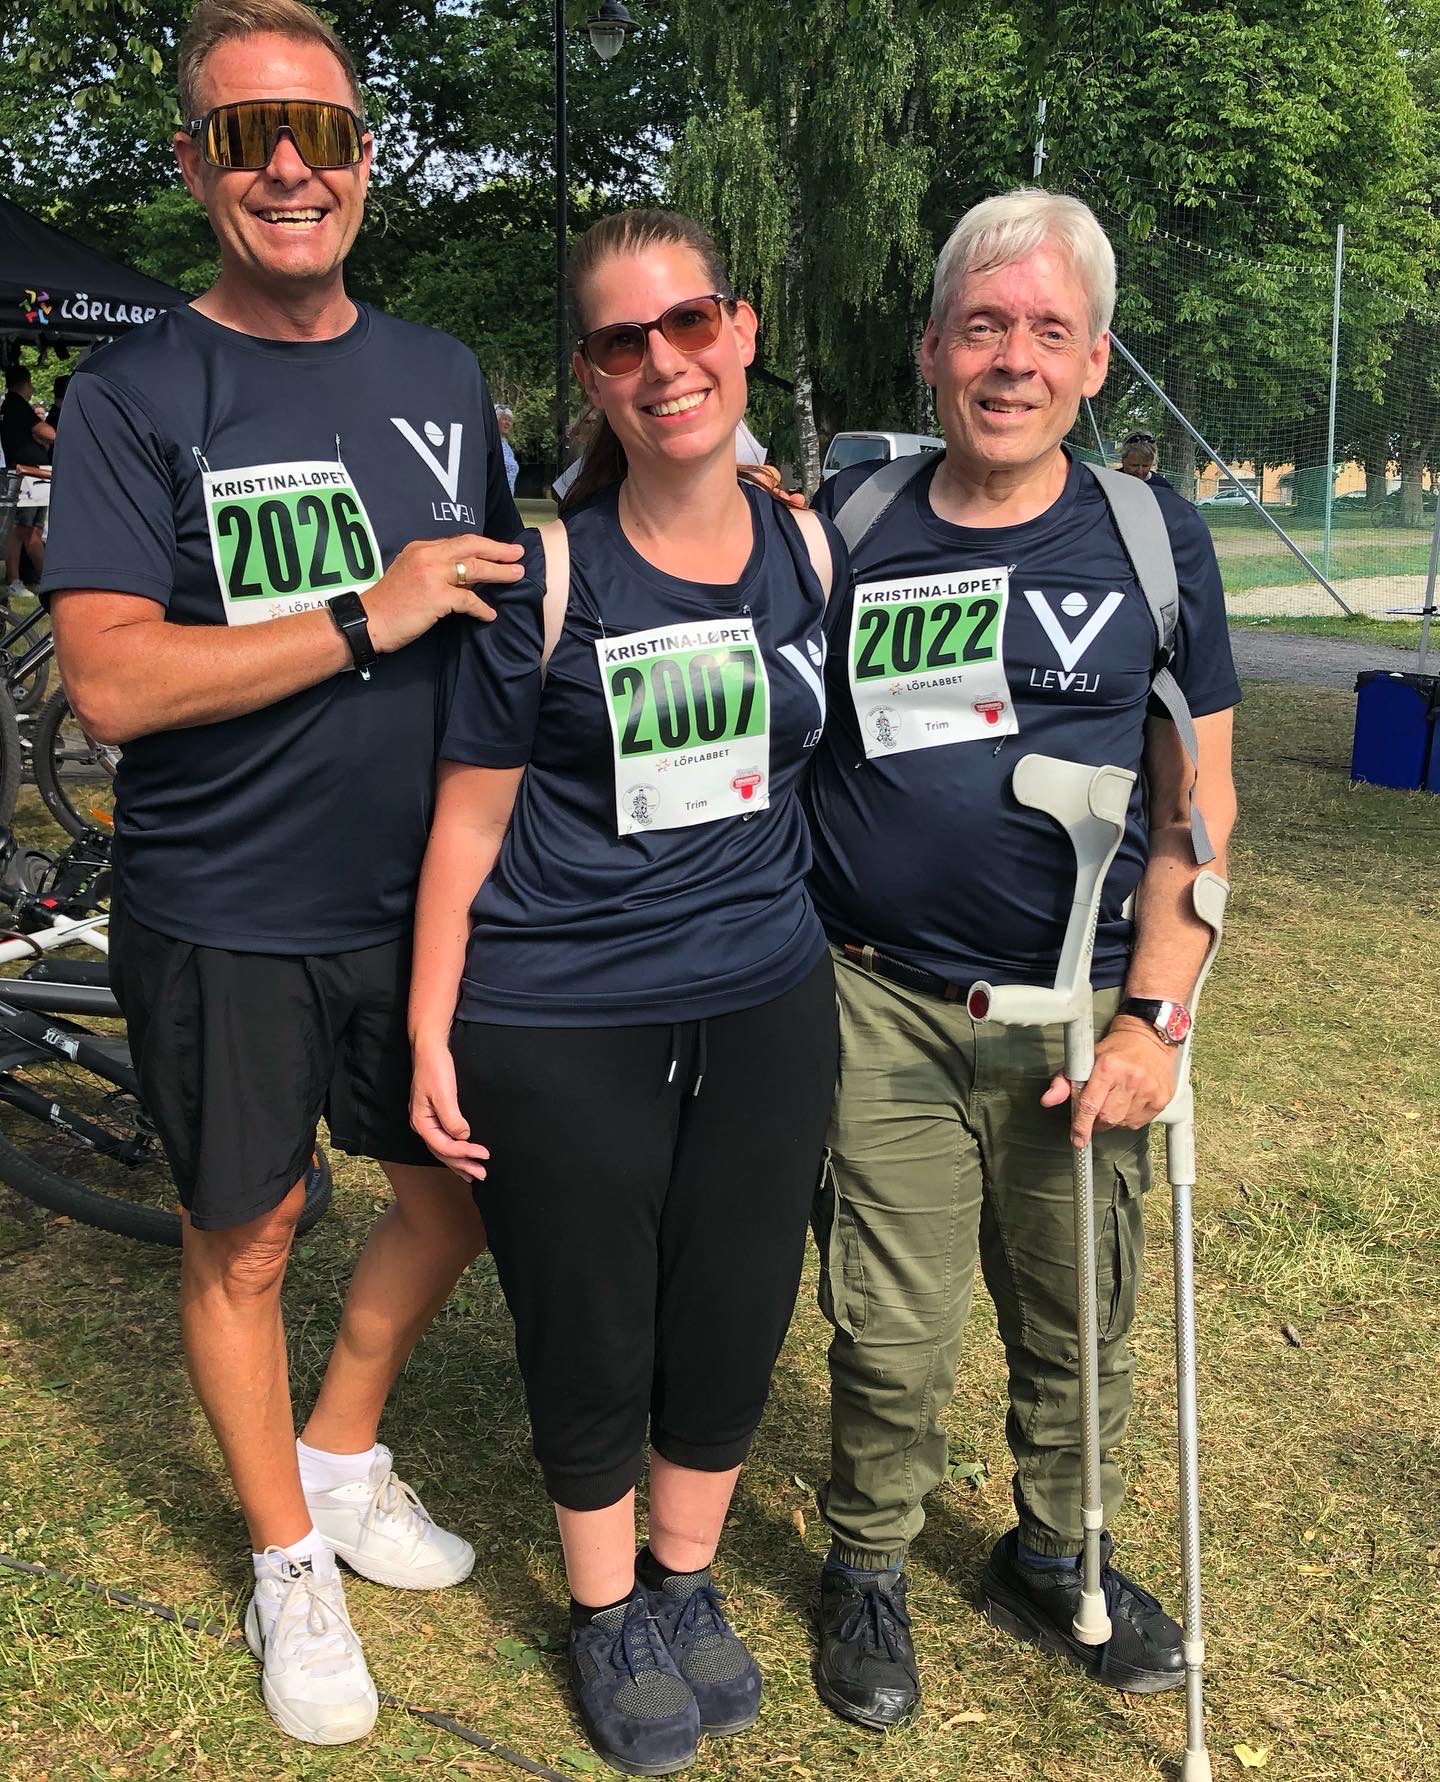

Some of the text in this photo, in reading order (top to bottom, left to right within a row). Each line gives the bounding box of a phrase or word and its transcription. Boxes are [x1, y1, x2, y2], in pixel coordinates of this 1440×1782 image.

[212, 471, 347, 498] KRISTINA-LØPET
[217, 492, 376, 598] 2026
[862, 577, 1003, 603] KRISTINA-LØPET
[605, 629, 751, 663] KRISTINA-LØPET
[856, 598, 999, 680] 2022
[906, 675, 963, 692] LÖPLABBET
[611, 649, 756, 755] 2007
[925, 720, 950, 732] Trim
[674, 748, 730, 768] LÖPLABBET
[685, 799, 709, 812] Trim
